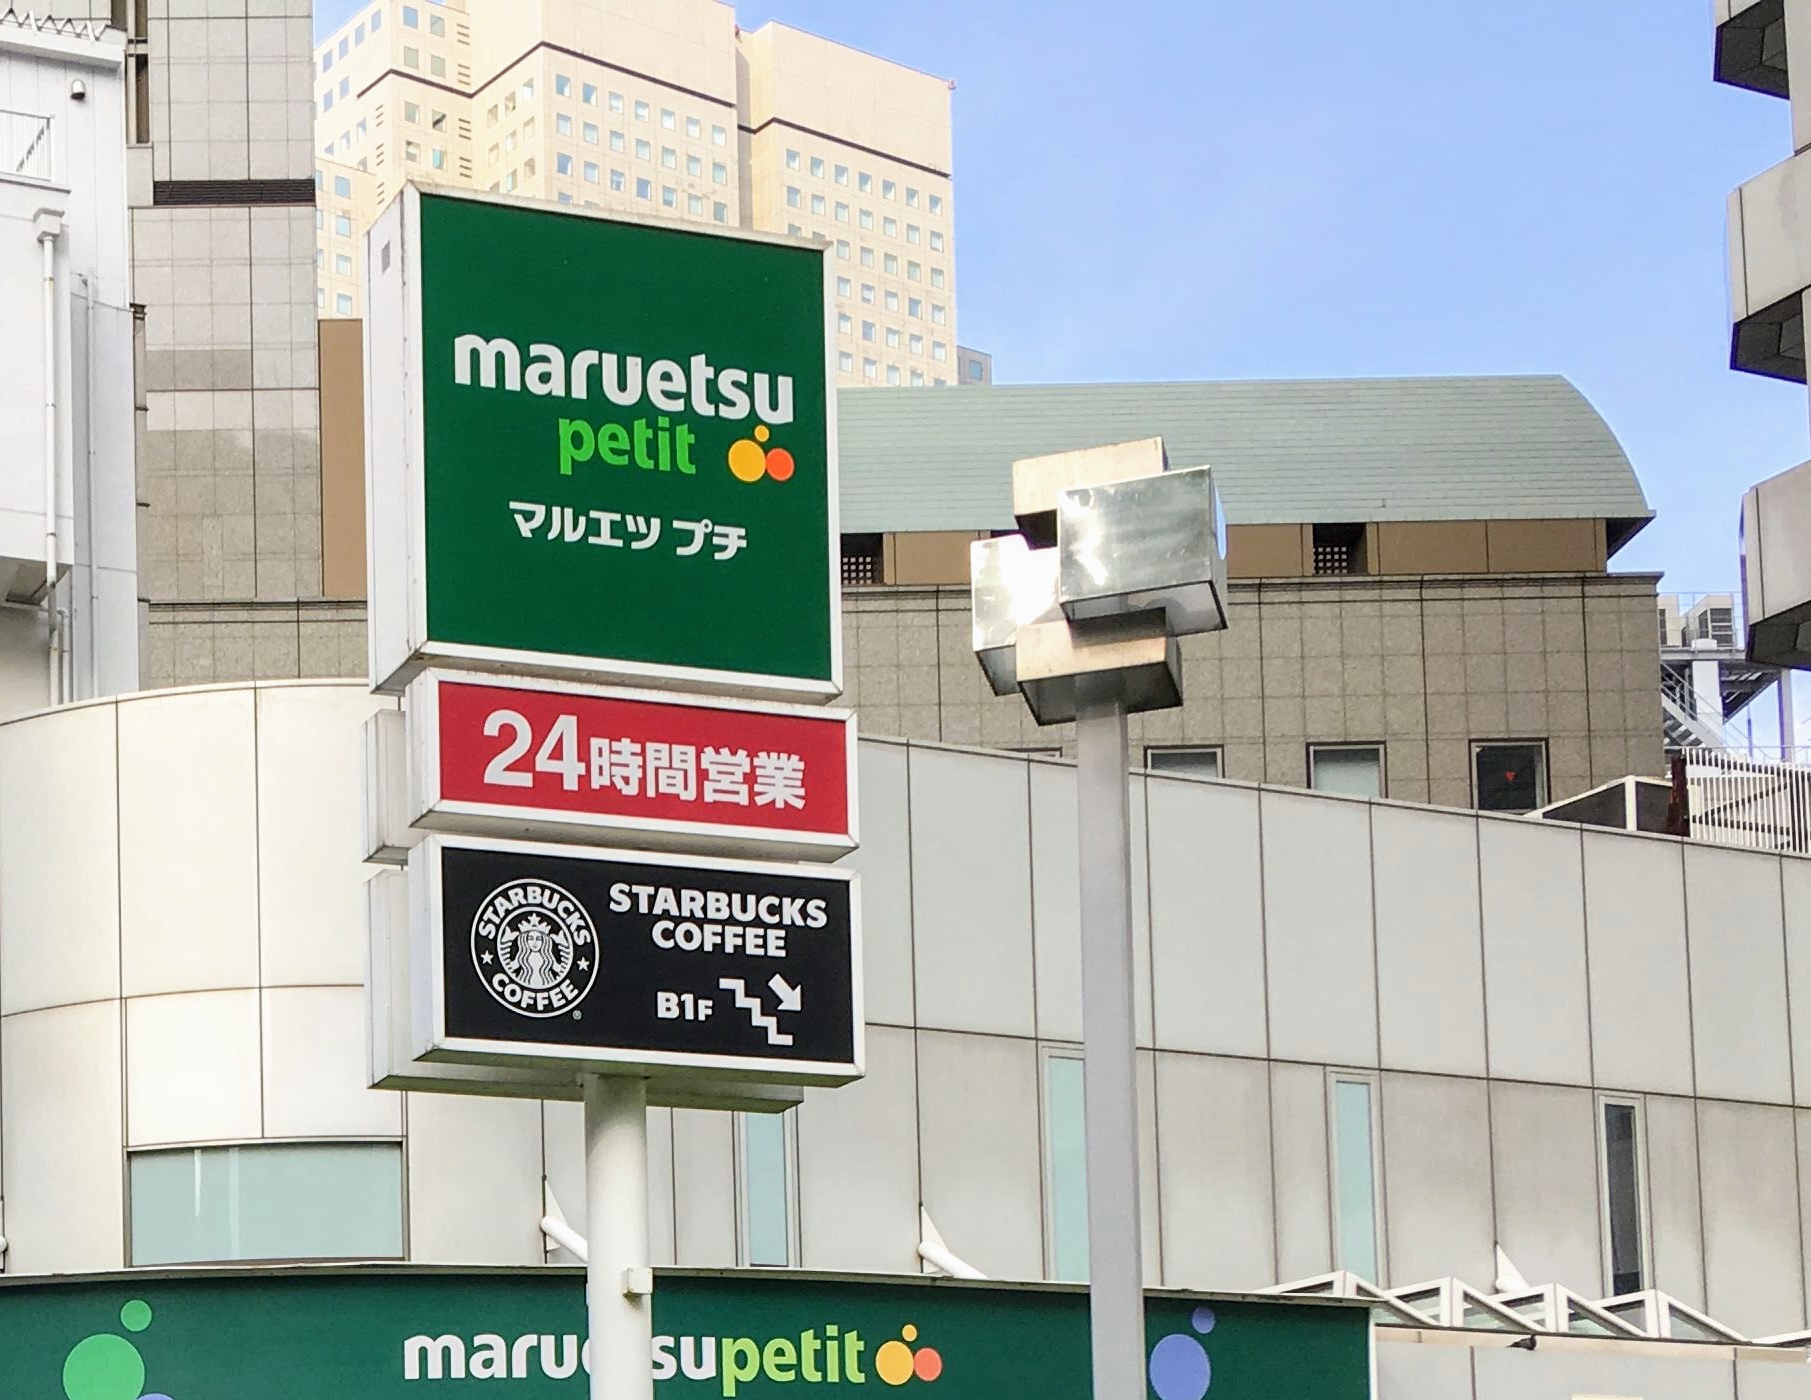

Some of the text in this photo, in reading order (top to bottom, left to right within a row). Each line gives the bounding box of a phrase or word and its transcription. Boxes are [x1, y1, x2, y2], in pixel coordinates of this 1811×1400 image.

[453, 333, 794, 425] maruetsu
[558, 415, 696, 475] petit
[509, 500, 747, 560] マルエツ プチ
[483, 708, 806, 810] 24時間営業
[478, 885, 591, 946] STARBUCKS
[609, 882, 828, 929] STARBUCKS
[651, 919, 787, 957] COFFEE
[492, 972, 579, 1011] COFFEE
[656, 990, 714, 1022] B1F
